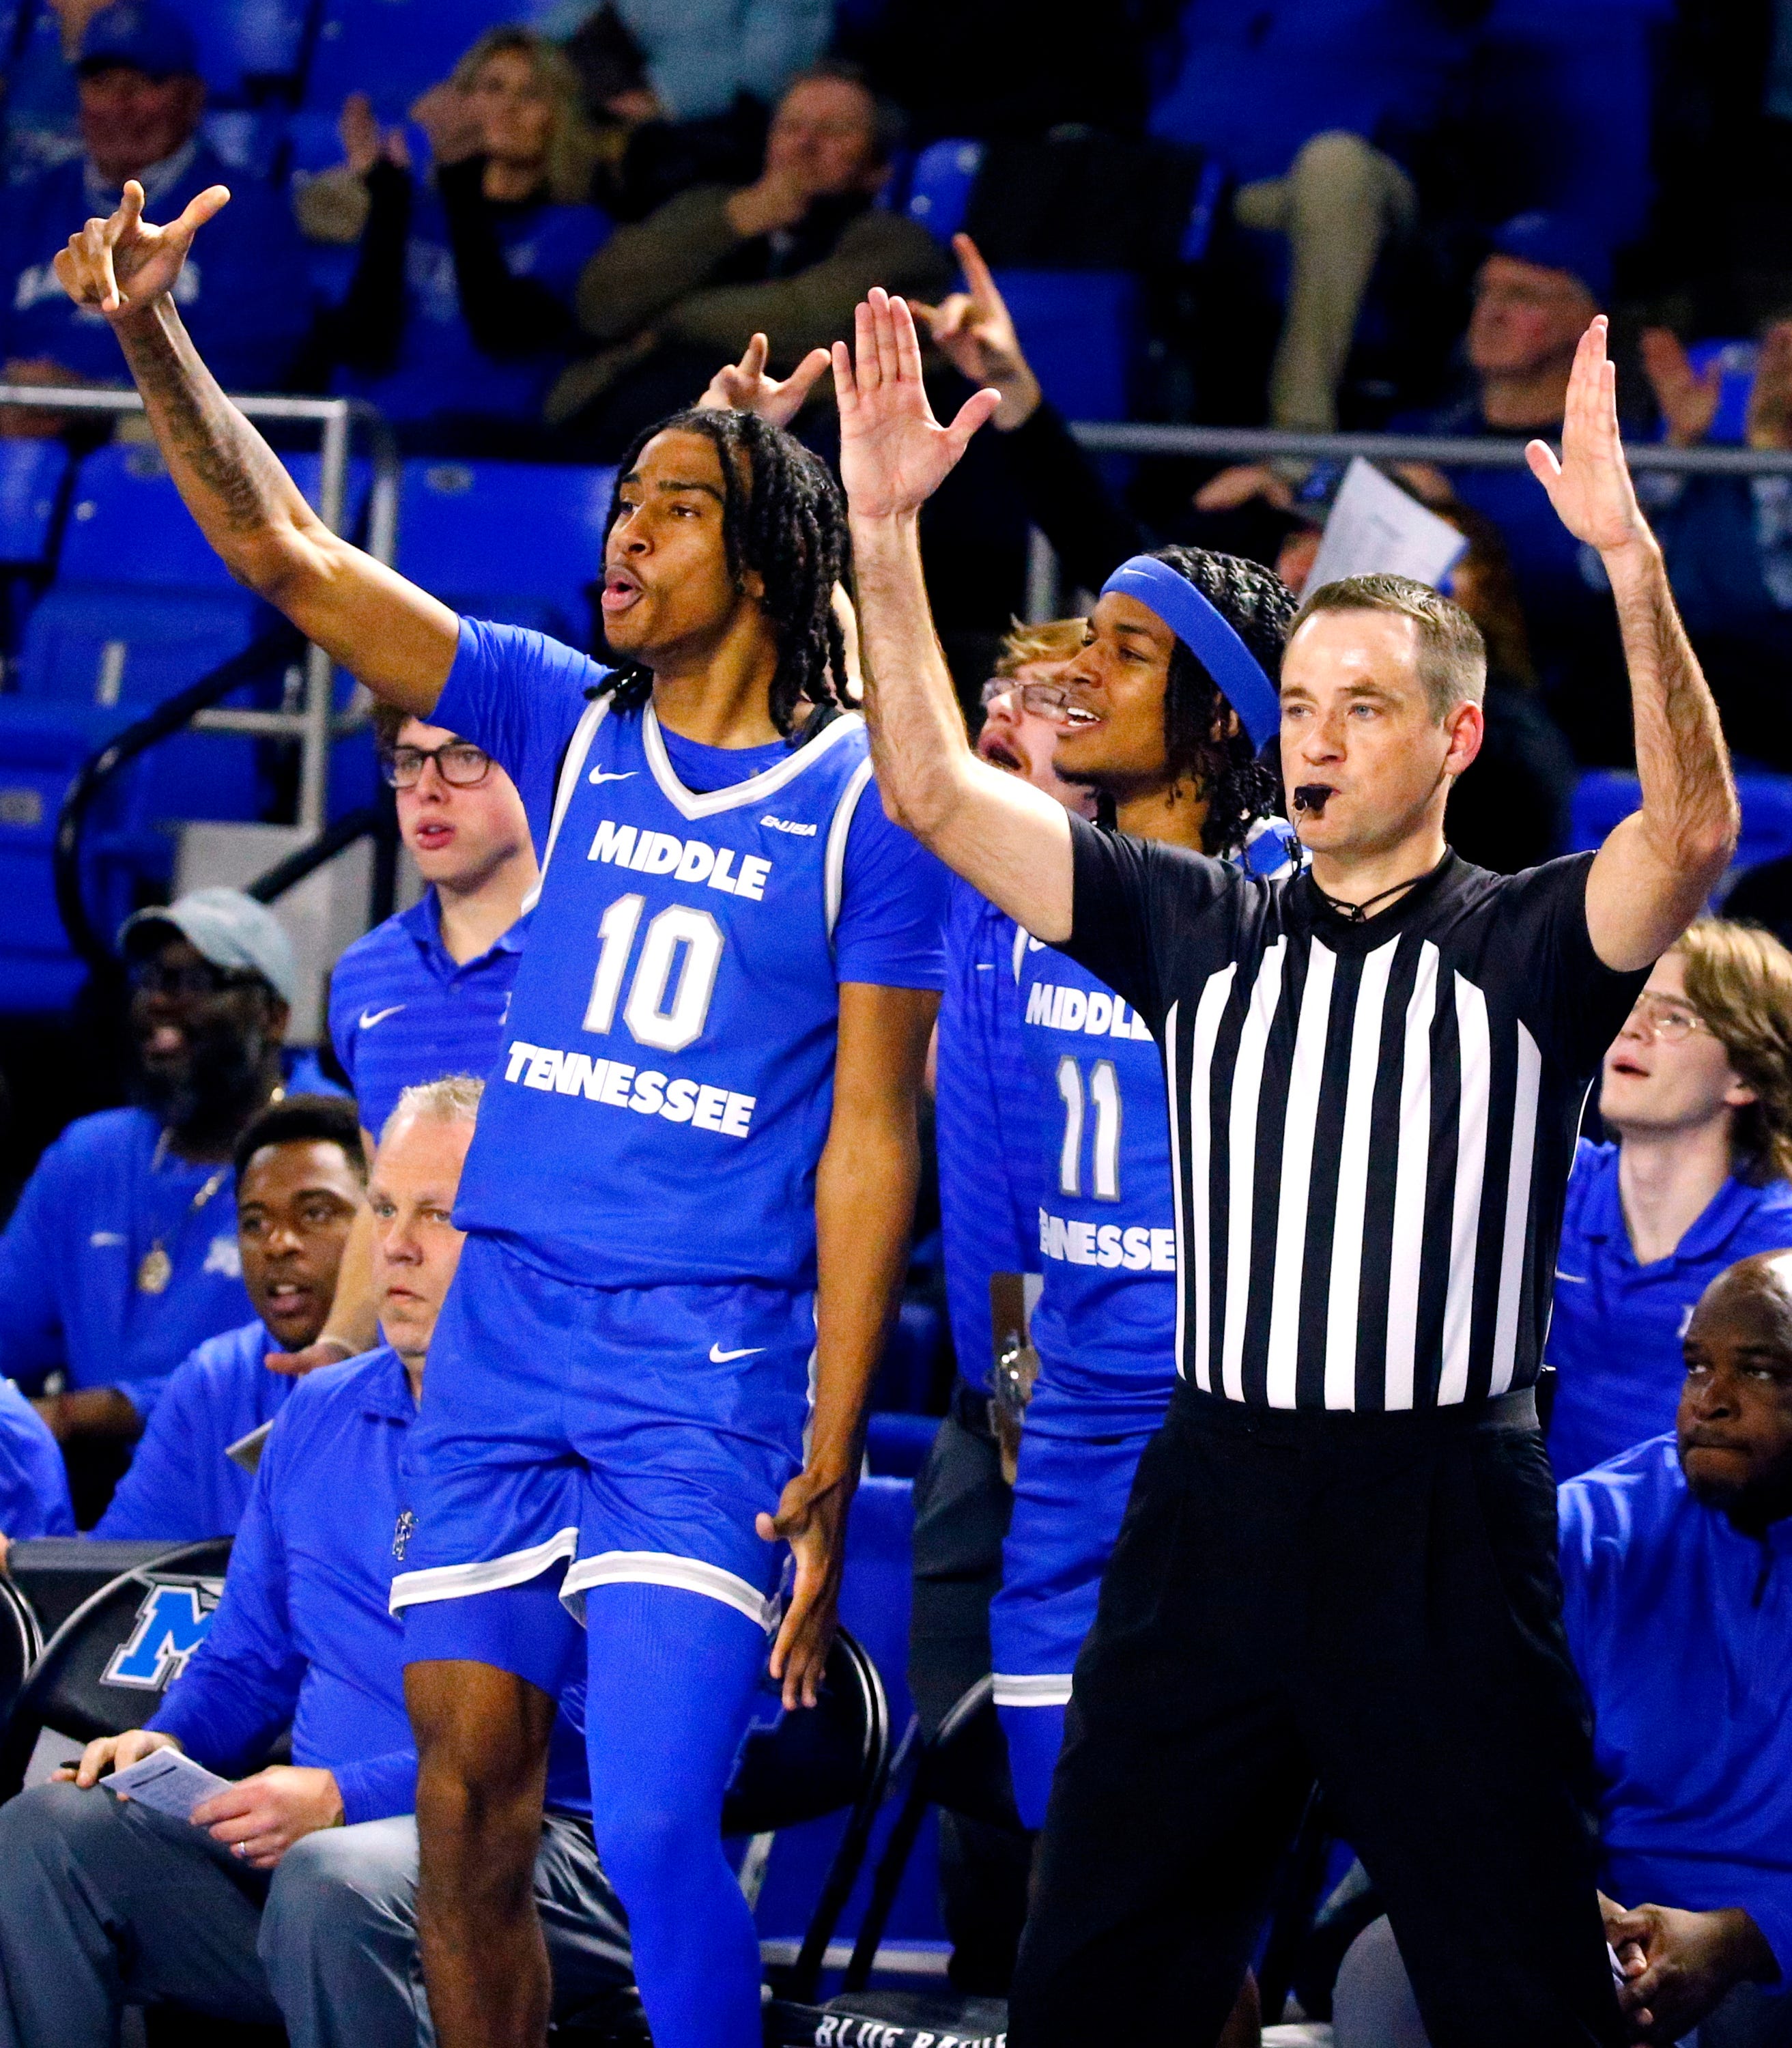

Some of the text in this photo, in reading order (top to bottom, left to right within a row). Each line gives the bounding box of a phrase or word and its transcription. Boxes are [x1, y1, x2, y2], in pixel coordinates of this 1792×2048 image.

[587, 820, 772, 901] MIDDLE
[582, 892, 725, 1053] 10
[504, 1040, 756, 1139] TENNESSEE
[1055, 1055, 1123, 1202] 11
